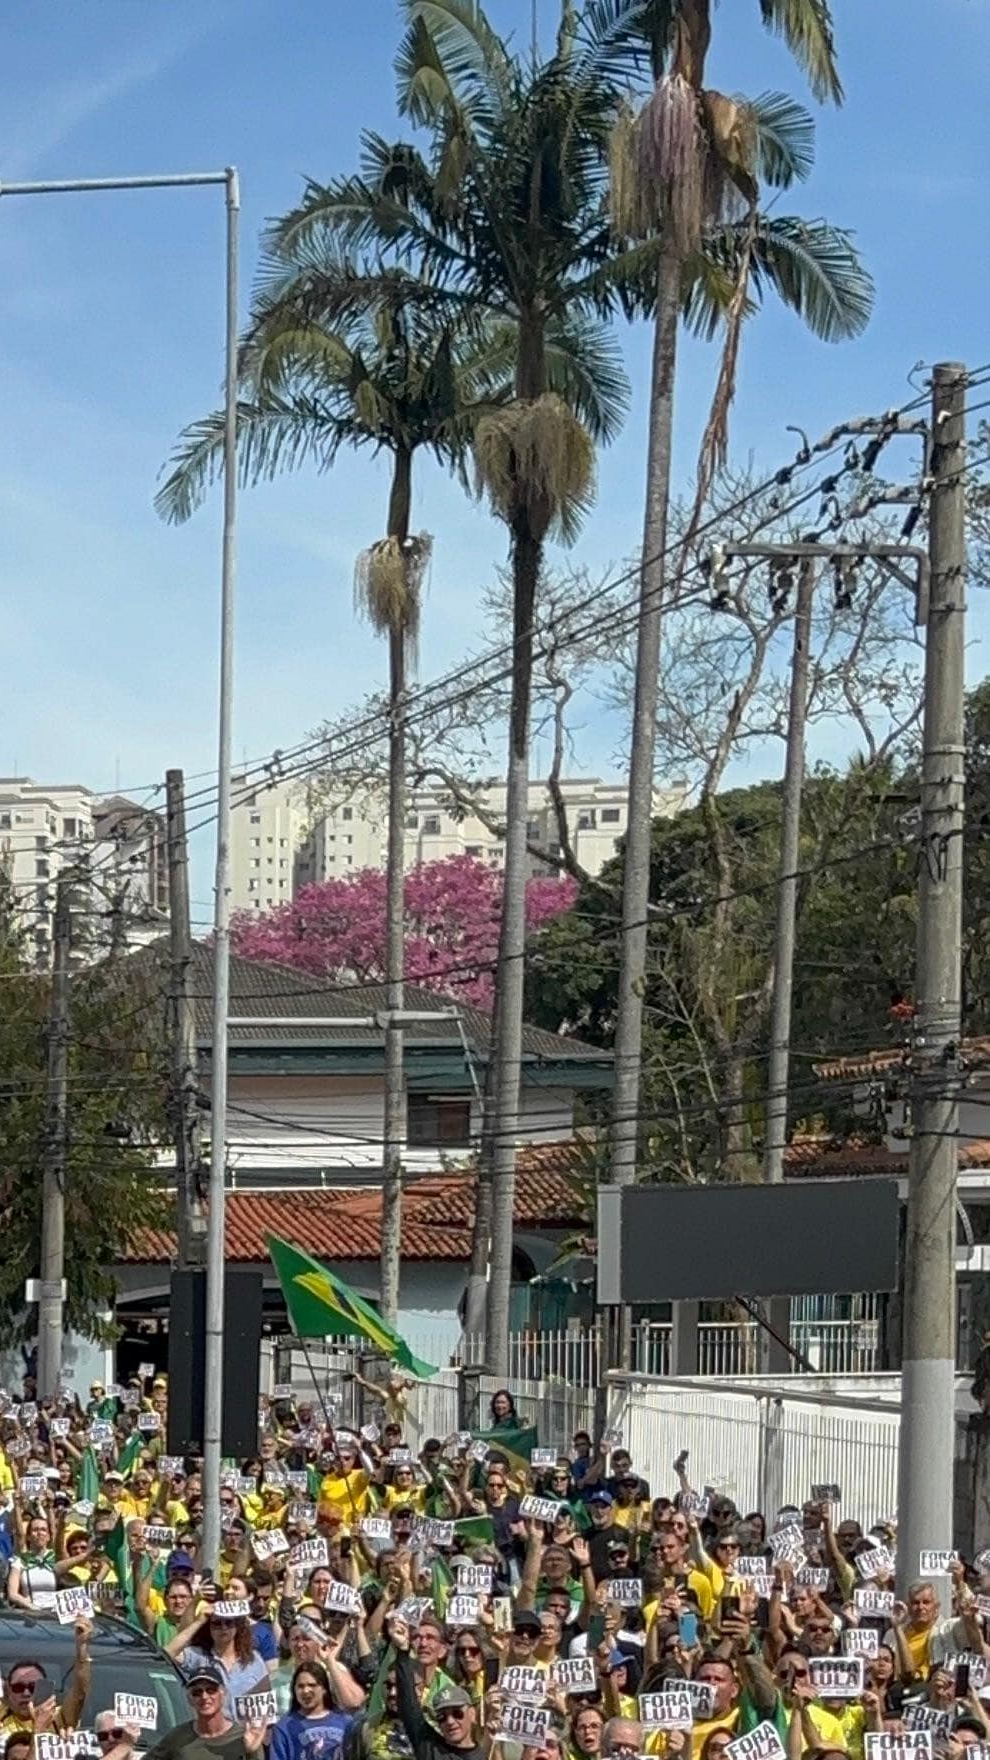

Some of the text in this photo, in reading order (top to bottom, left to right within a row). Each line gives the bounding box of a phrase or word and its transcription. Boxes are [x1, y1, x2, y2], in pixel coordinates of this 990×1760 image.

[117, 1694, 155, 1706] FORA
[641, 1693, 690, 1708] FORA
[116, 1704, 155, 1719] LULA
[503, 1704, 546, 1724] FORA
[642, 1706, 690, 1721] LULA
[509, 1718, 545, 1736] ULA
[728, 1724, 776, 1757] FORA
[867, 1733, 930, 1749] FORA
